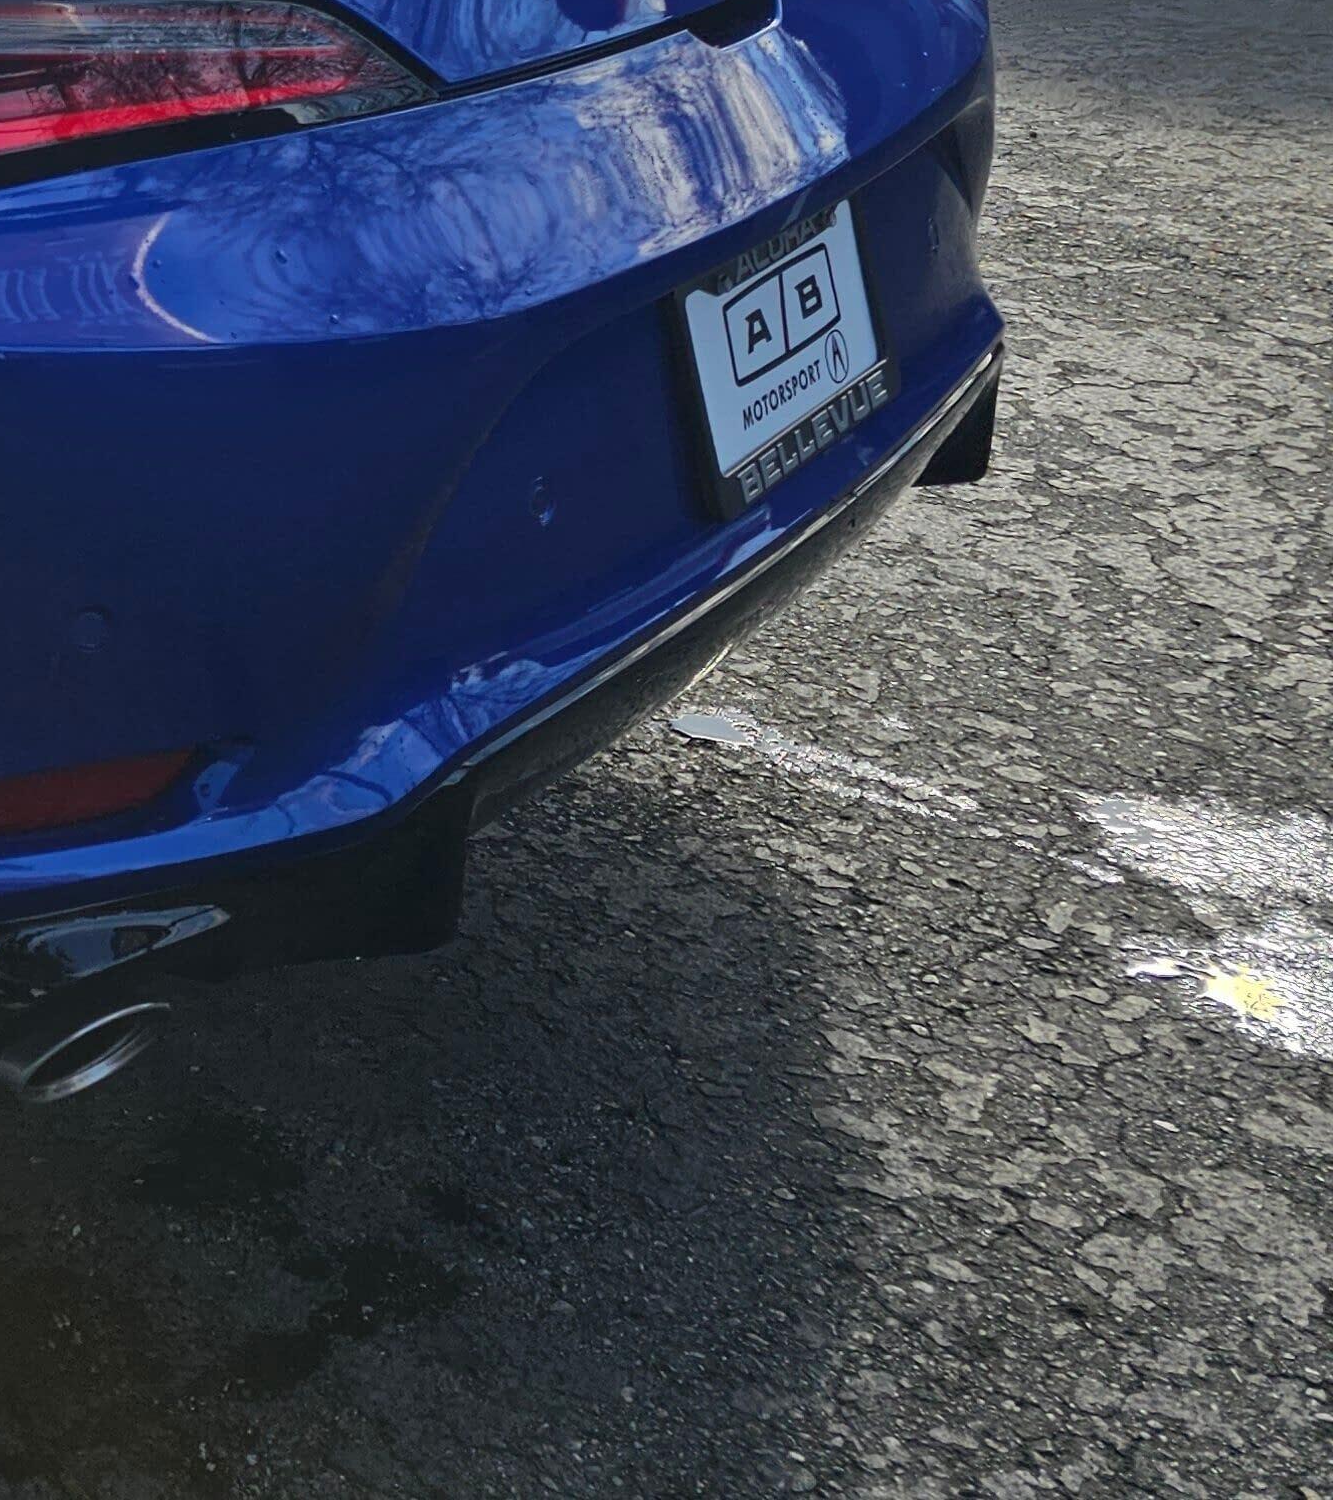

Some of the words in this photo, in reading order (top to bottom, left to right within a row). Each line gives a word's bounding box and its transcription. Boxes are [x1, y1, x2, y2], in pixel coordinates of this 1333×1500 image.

[744, 308, 773, 355] A
[794, 274, 823, 320] B
[742, 358, 821, 431] MOTORSPORT
[736, 368, 888, 504] BELLEVUE
